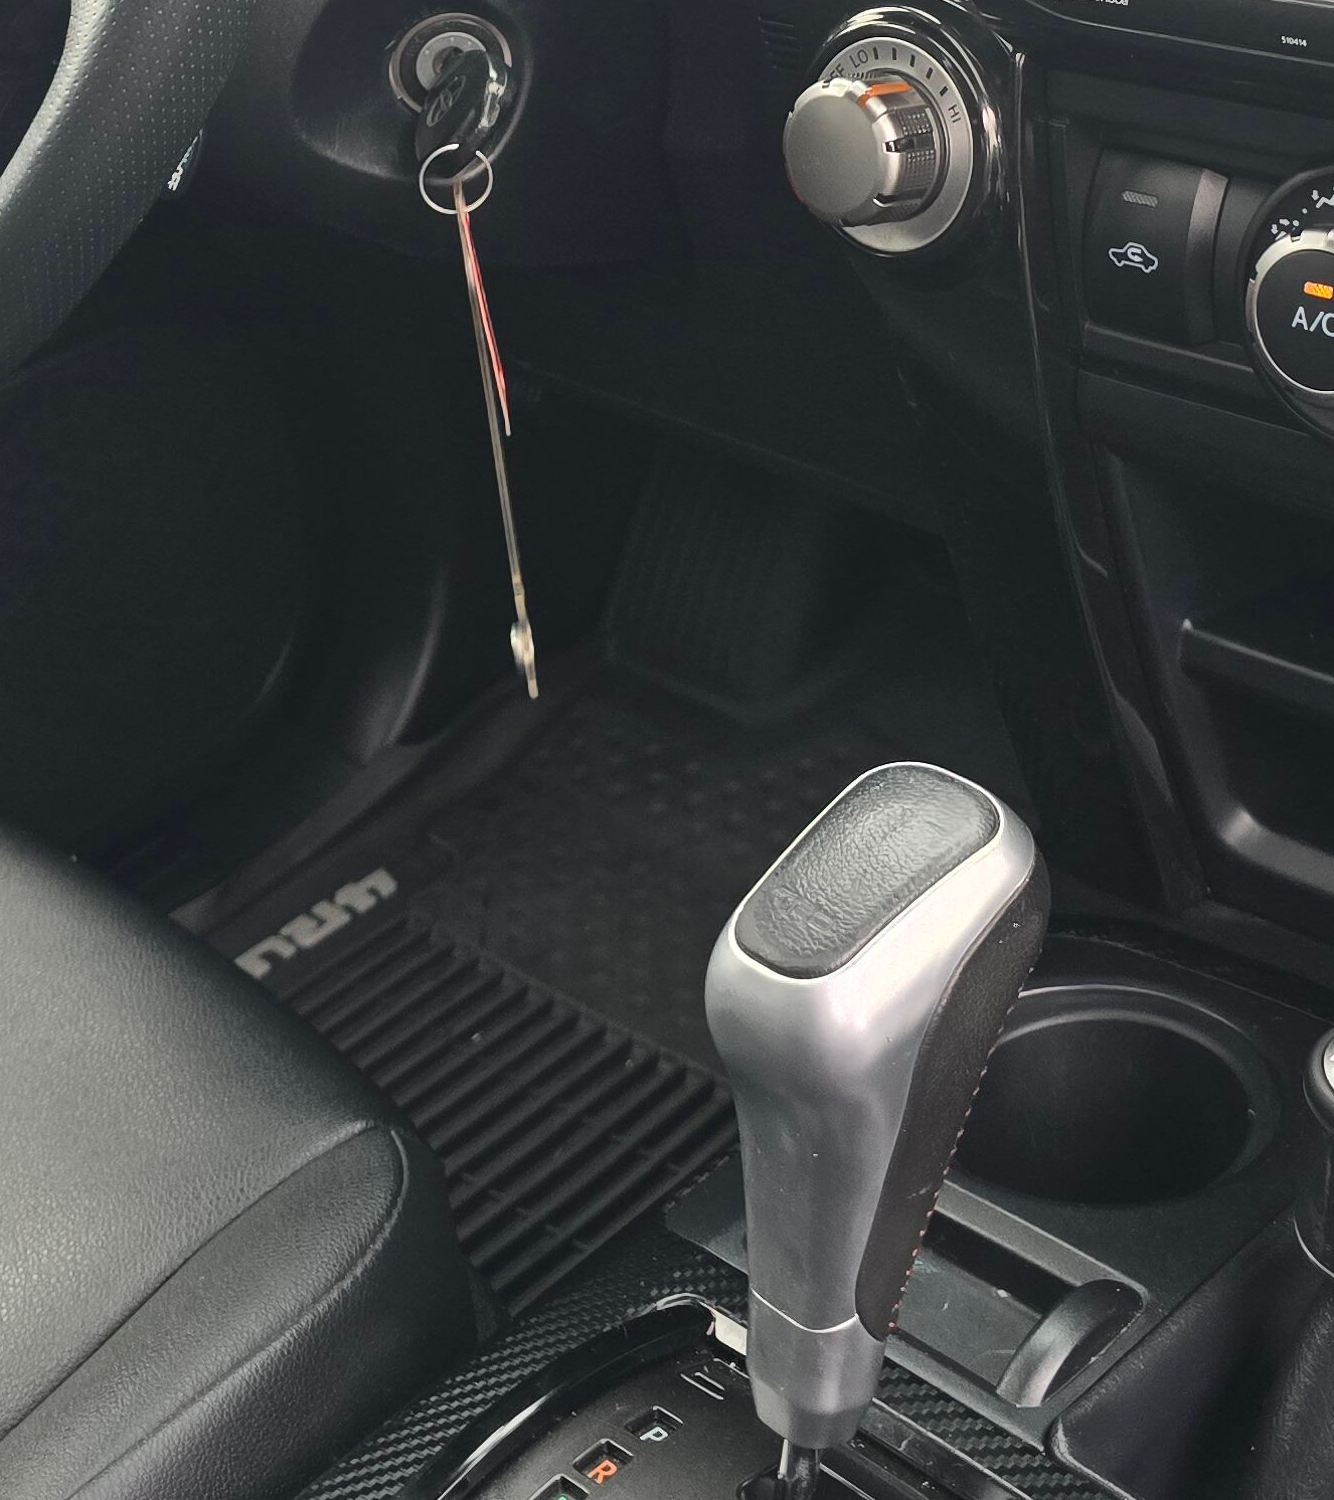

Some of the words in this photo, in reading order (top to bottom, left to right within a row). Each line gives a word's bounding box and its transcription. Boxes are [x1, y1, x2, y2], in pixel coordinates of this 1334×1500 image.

[850, 49, 869, 69] LO
[948, 104, 961, 124] HI
[639, 1426, 669, 1442] P
[586, 1459, 618, 1485] R
